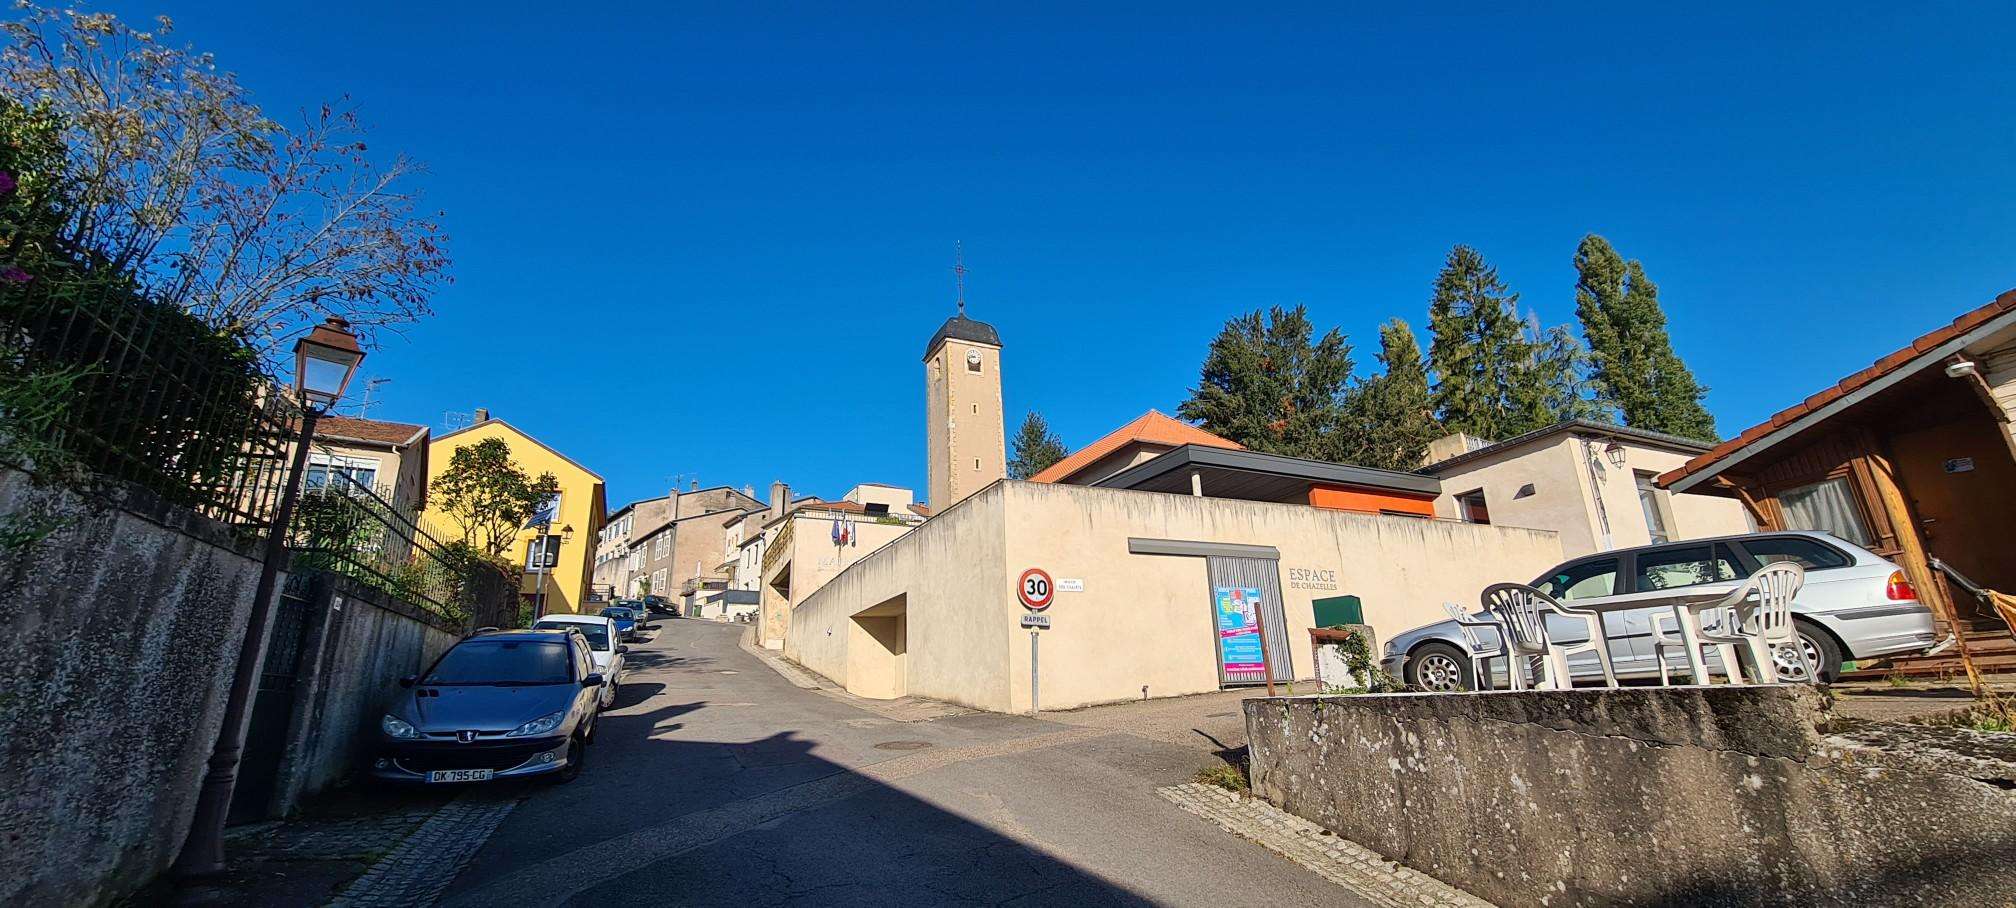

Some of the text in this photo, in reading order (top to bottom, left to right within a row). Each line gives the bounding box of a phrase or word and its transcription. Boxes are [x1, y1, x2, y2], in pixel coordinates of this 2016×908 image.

[1289, 568, 1336, 582] ESPACE
[1026, 579, 1047, 596] 30
[1301, 582, 1337, 590] CHAZELLES
[1024, 615, 1048, 624] RAPPEL
